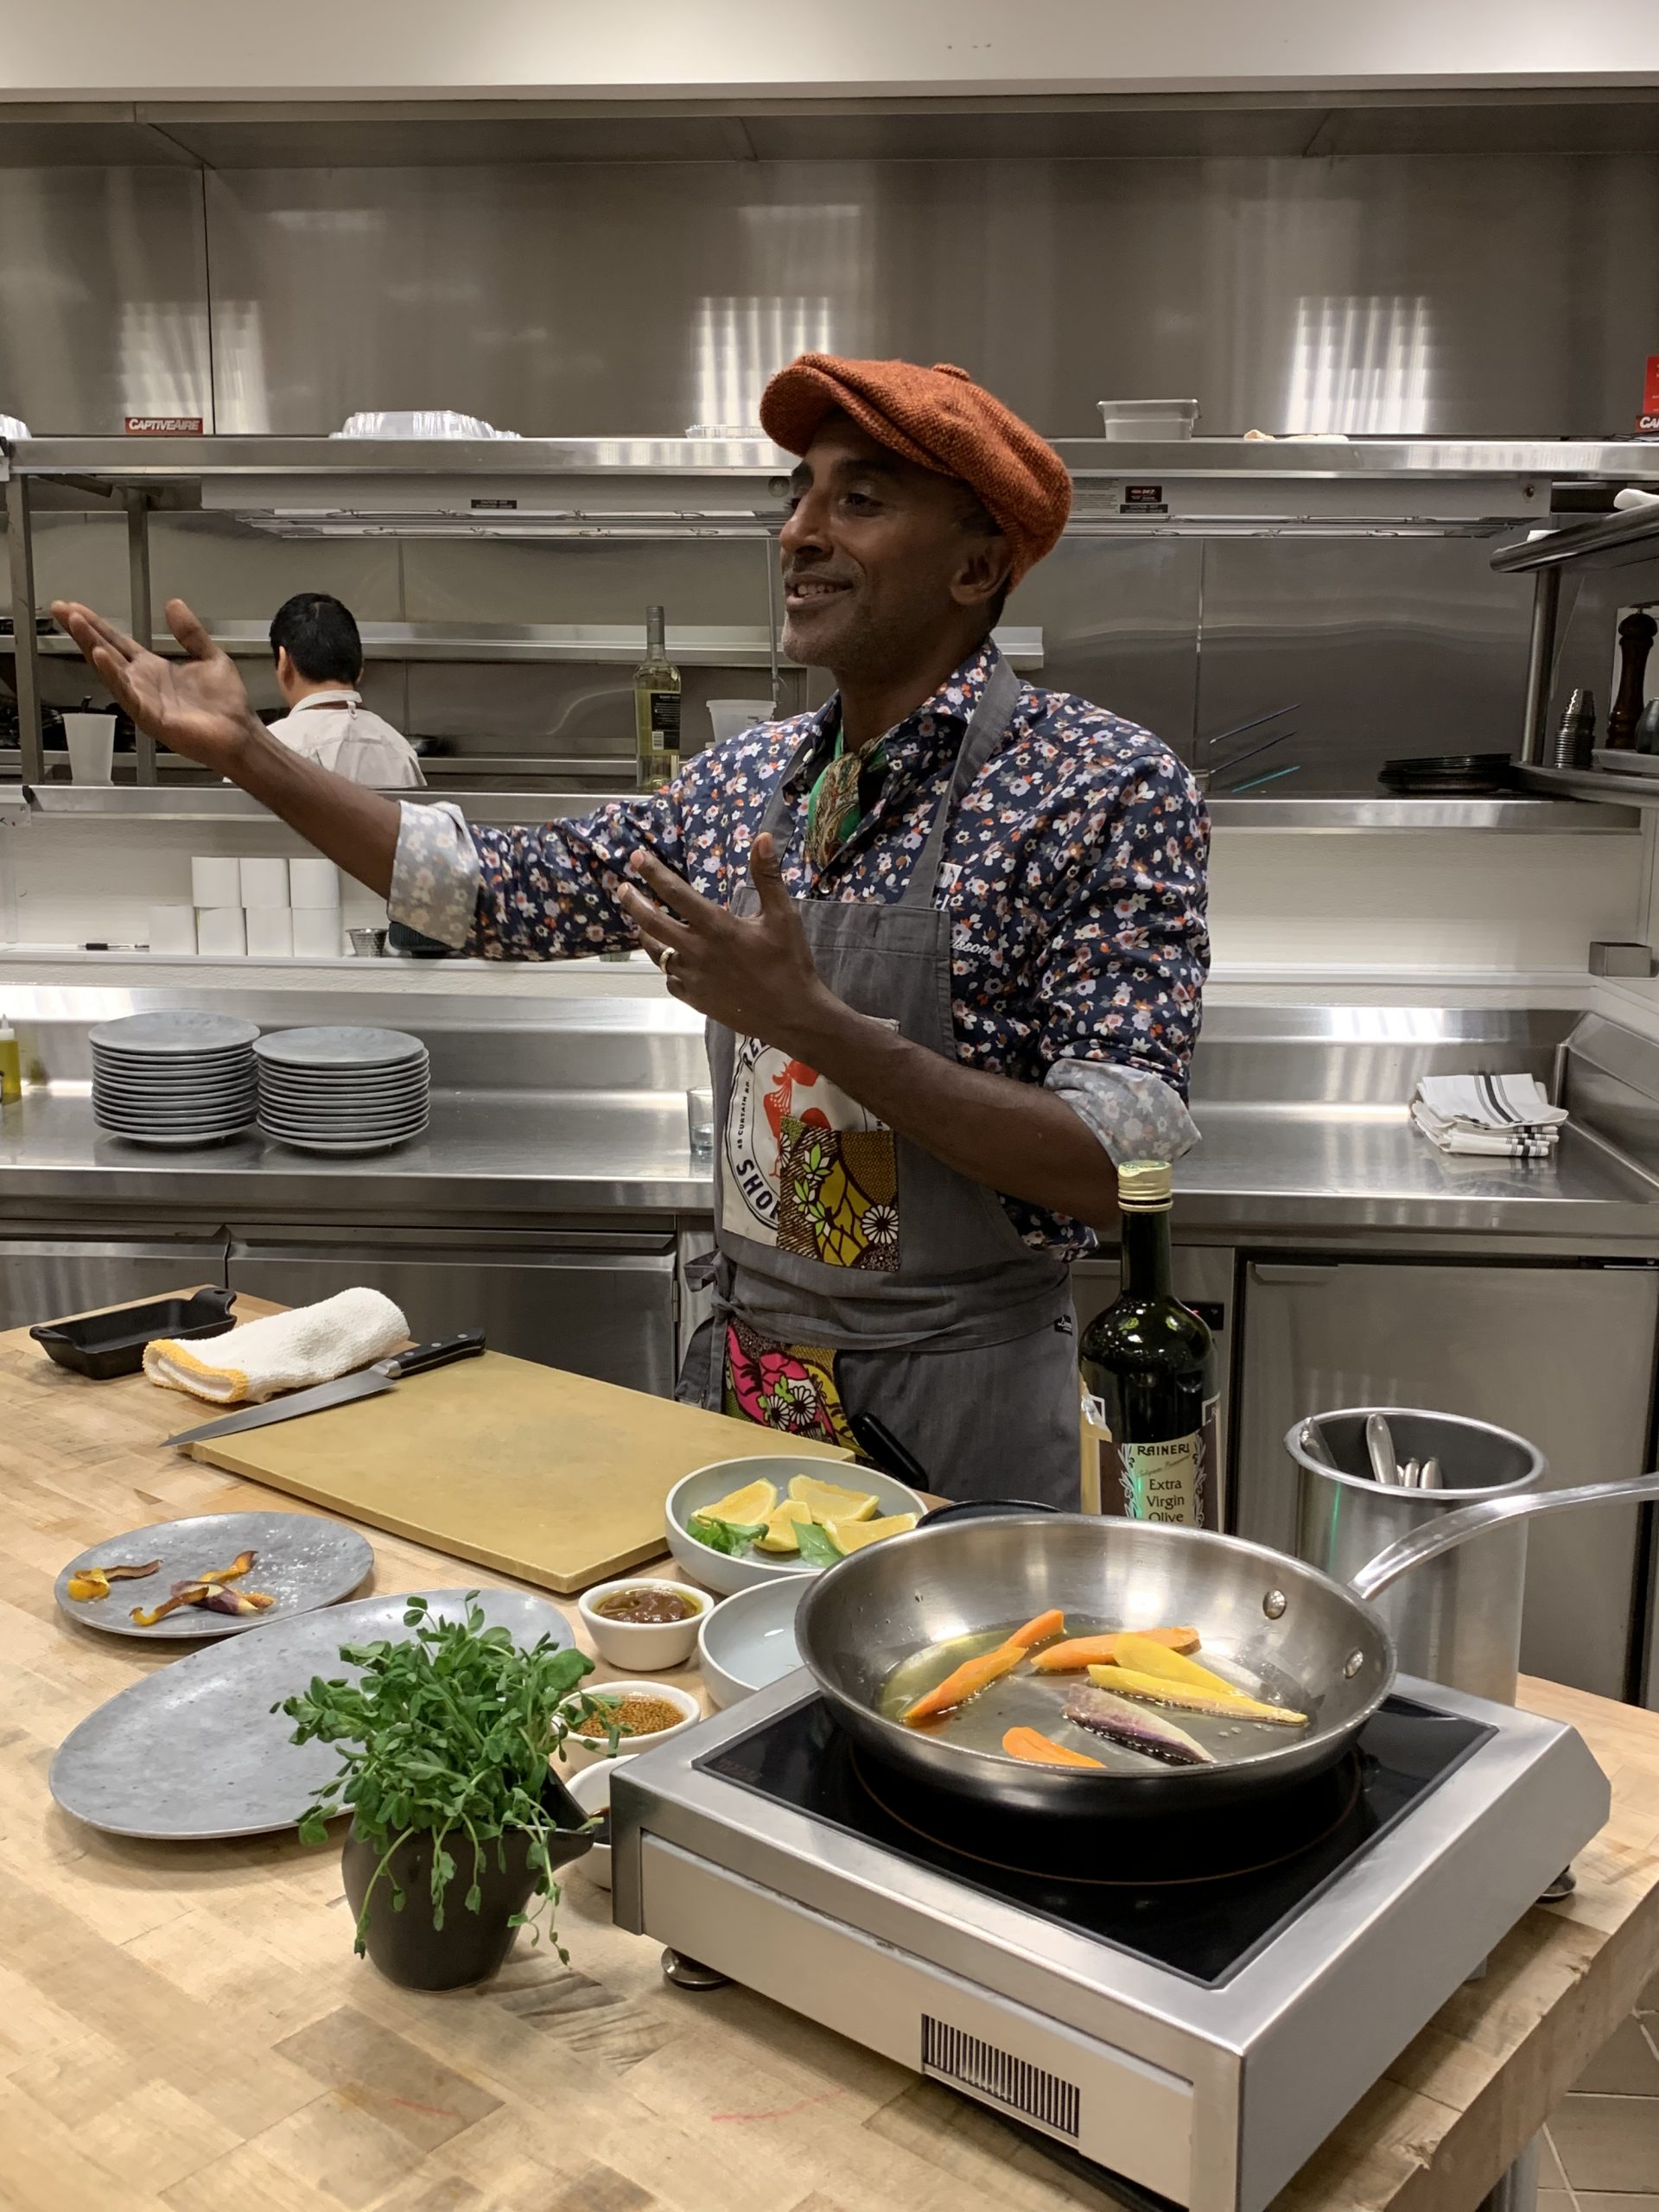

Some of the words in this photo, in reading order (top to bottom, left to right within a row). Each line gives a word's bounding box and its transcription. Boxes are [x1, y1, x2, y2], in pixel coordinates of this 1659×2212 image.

[129, 418, 200, 430] CAPTIVEAIRE
[738, 1096, 747, 1135] CURTAIN
[1137, 1442, 1190, 1456] RAINERI
[1149, 1478, 1182, 1491] Extra
[1147, 1495, 1185, 1510] Virgin
[1148, 1511, 1184, 1522] Olive
